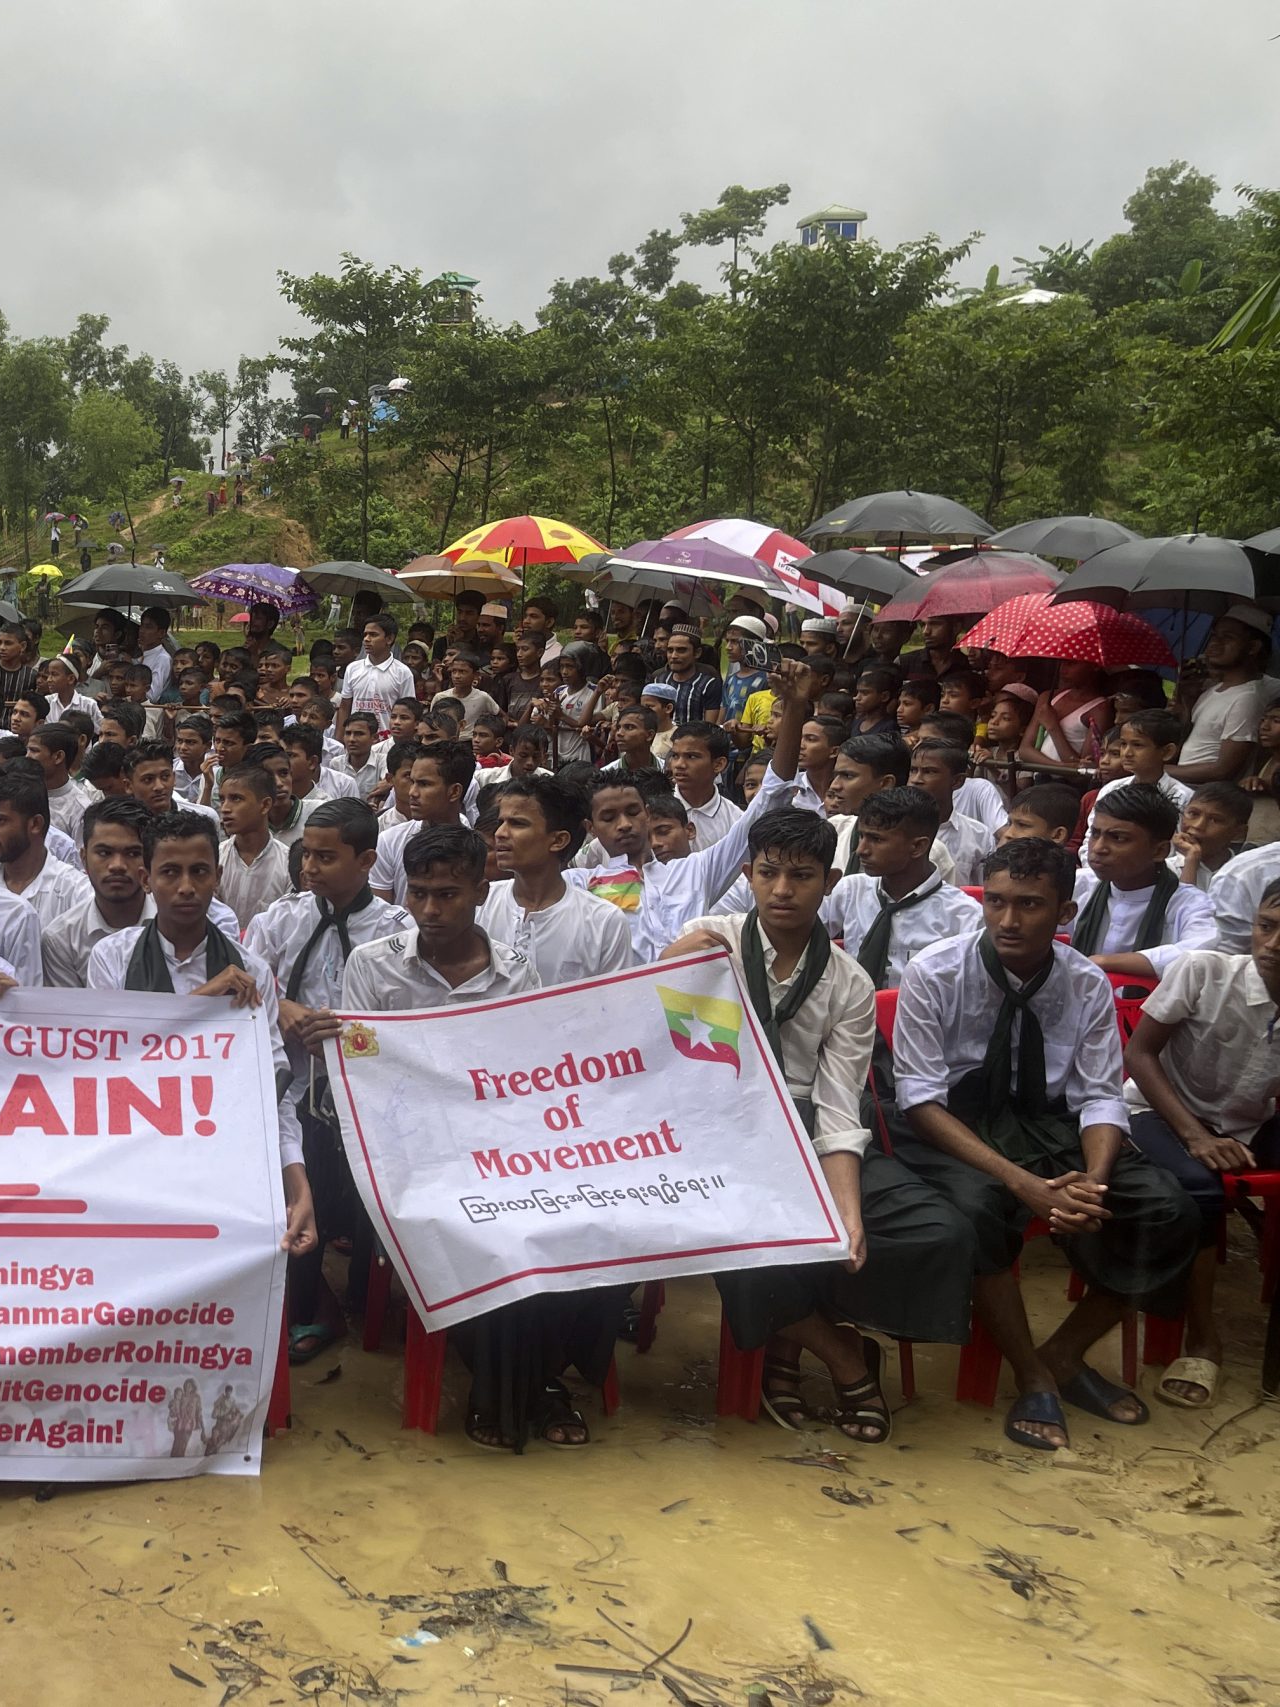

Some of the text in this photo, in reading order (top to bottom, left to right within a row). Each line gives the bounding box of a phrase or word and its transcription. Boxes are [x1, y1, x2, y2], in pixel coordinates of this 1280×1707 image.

[777, 562, 797, 575] IFRC
[140, 1032, 236, 1061] 2017
[467, 1045, 646, 1101] Freedom
[542, 1093, 585, 1132] of
[471, 1119, 683, 1180] Movement
